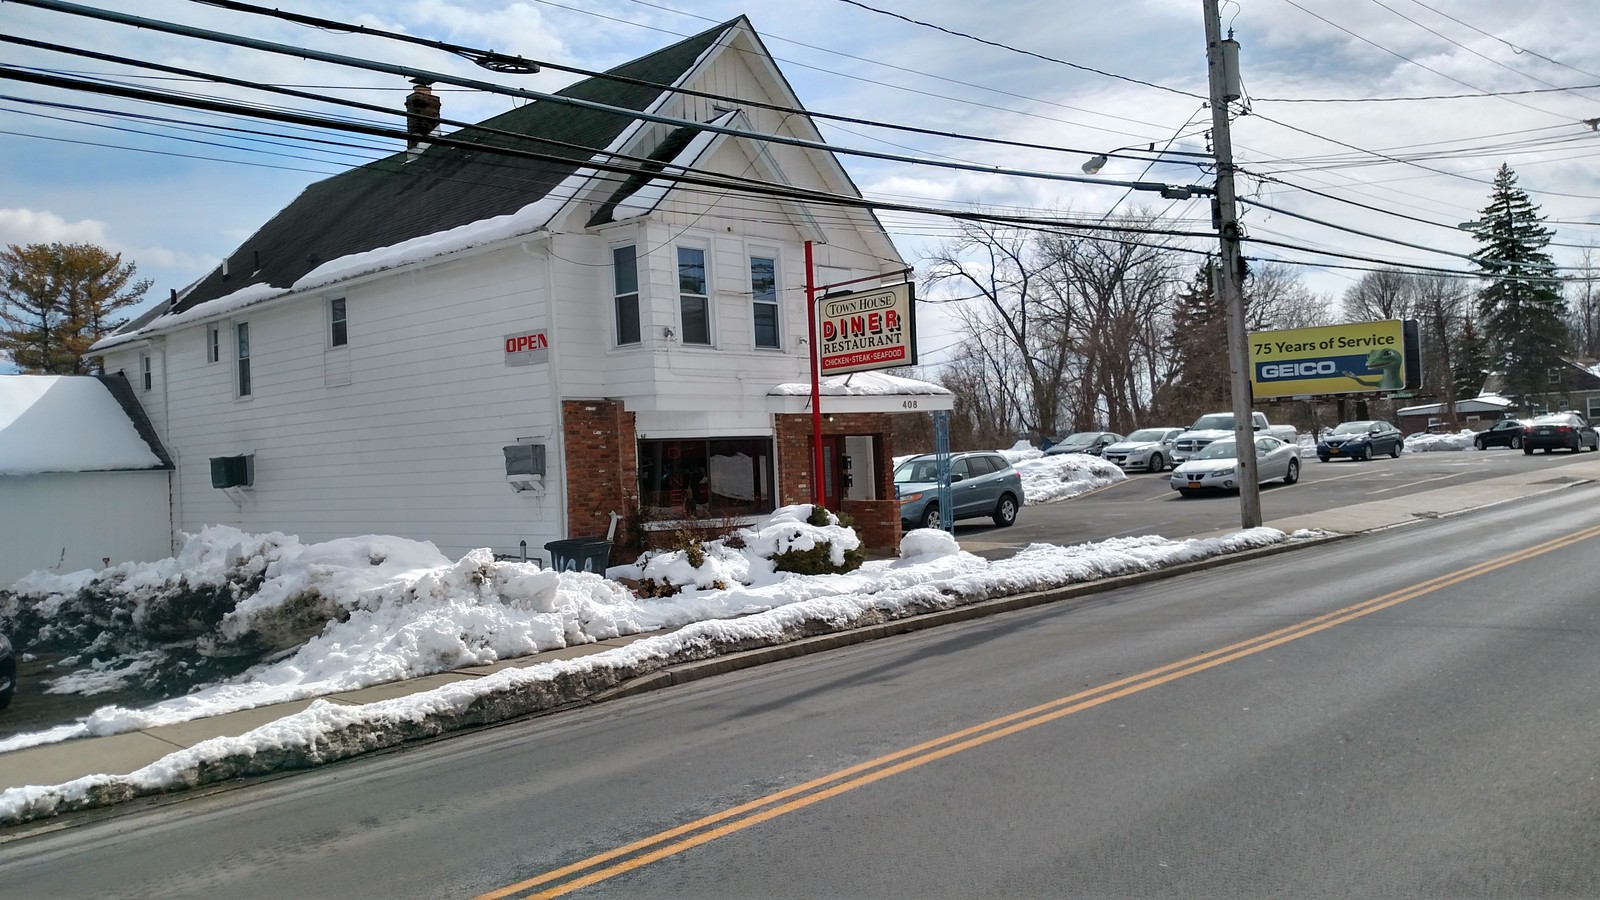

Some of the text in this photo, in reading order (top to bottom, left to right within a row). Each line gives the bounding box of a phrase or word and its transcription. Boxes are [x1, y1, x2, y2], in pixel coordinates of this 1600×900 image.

[829, 295, 892, 315] TOWN HOUSE
[823, 310, 901, 341] DINER
[505, 333, 548, 352] OPEN
[823, 333, 902, 354] RESTAURANT
[1254, 333, 1395, 355] 75 Years of Service
[1261, 360, 1336, 379] GEICO
[902, 400, 918, 409] 408
